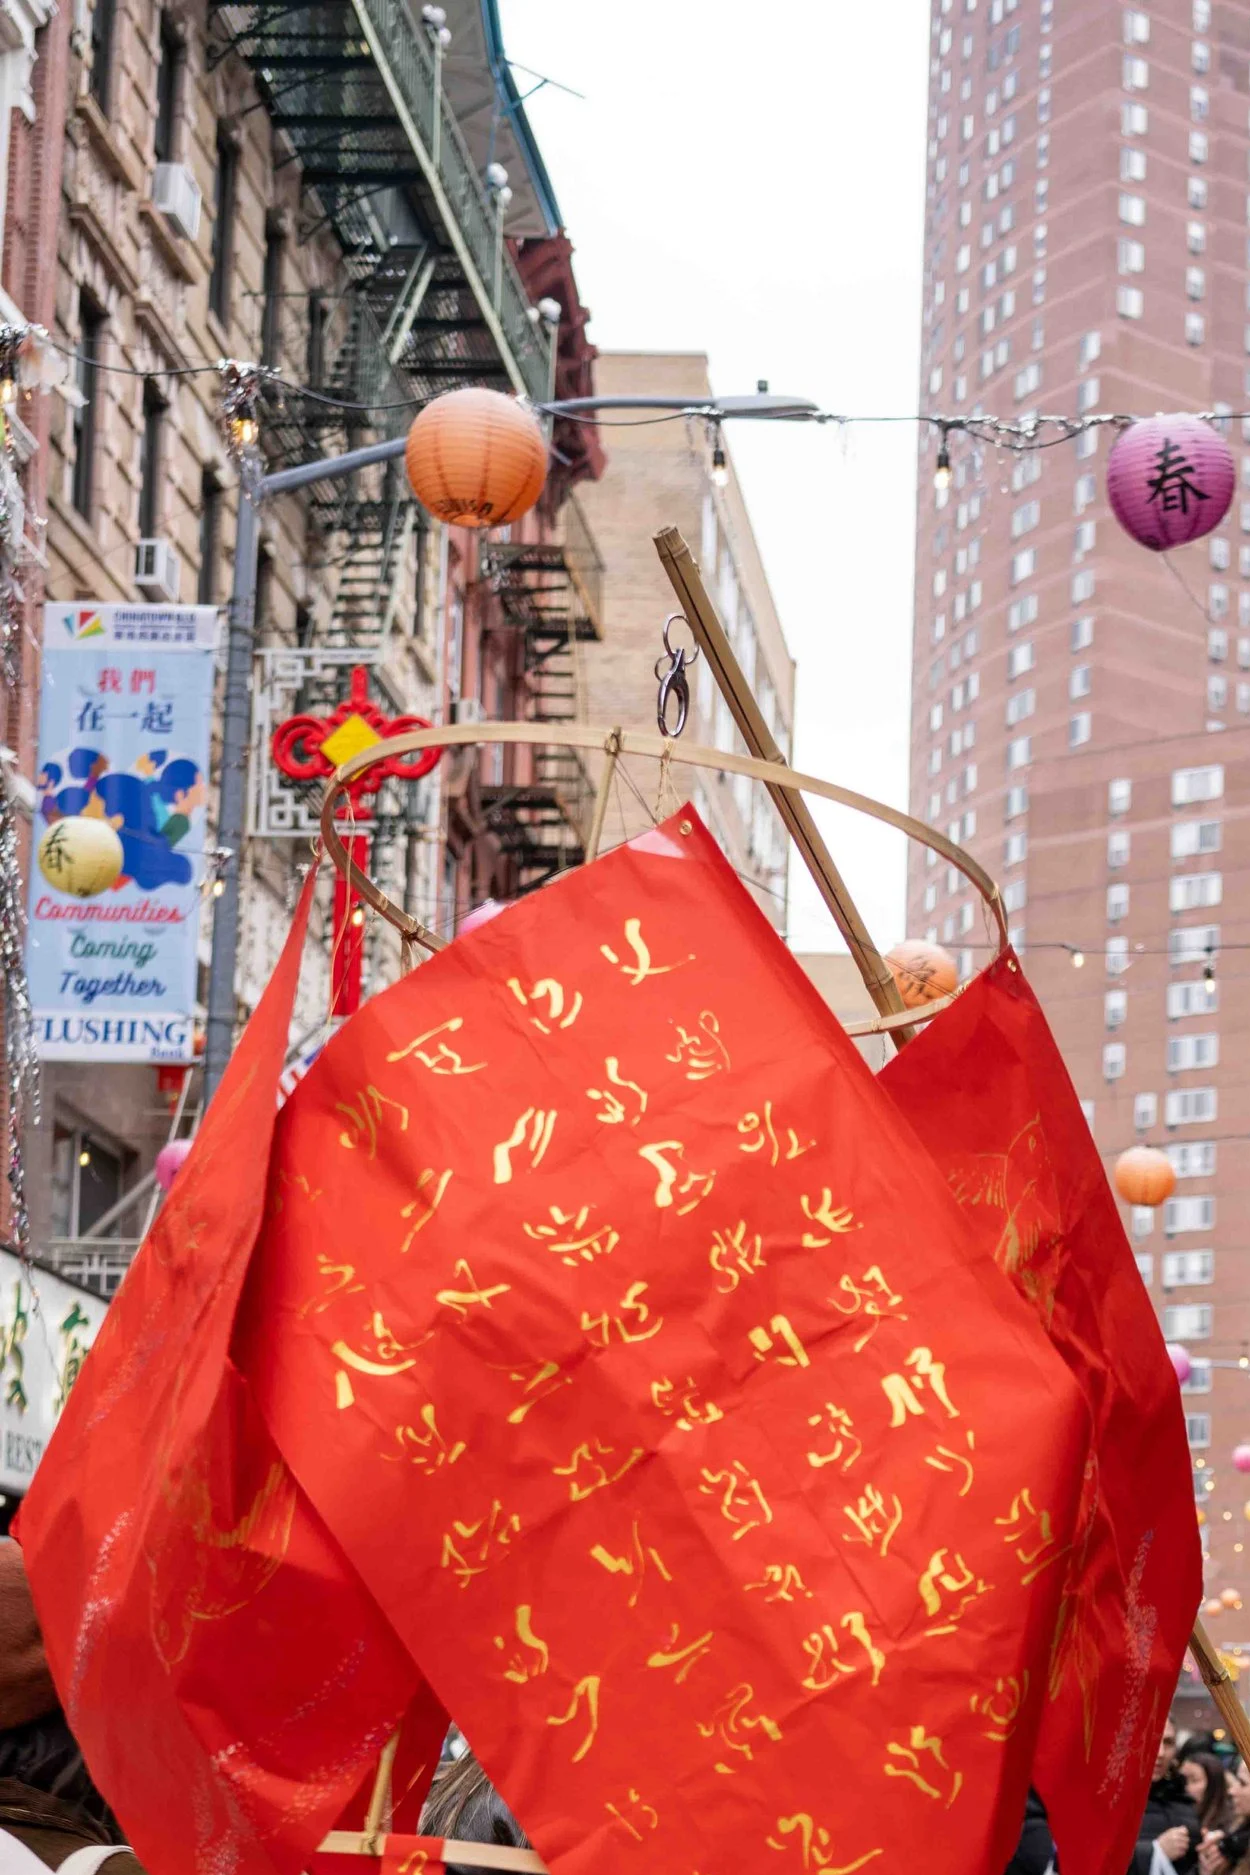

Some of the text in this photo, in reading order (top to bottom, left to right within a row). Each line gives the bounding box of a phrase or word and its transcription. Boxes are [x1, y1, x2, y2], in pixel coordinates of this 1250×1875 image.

[1145, 438, 1211, 515] 春
[98, 668, 157, 694] 我們
[77, 700, 174, 734] 在一起
[33, 896, 187, 923] Communities
[69, 931, 158, 968] Coming
[59, 970, 166, 1004] Together
